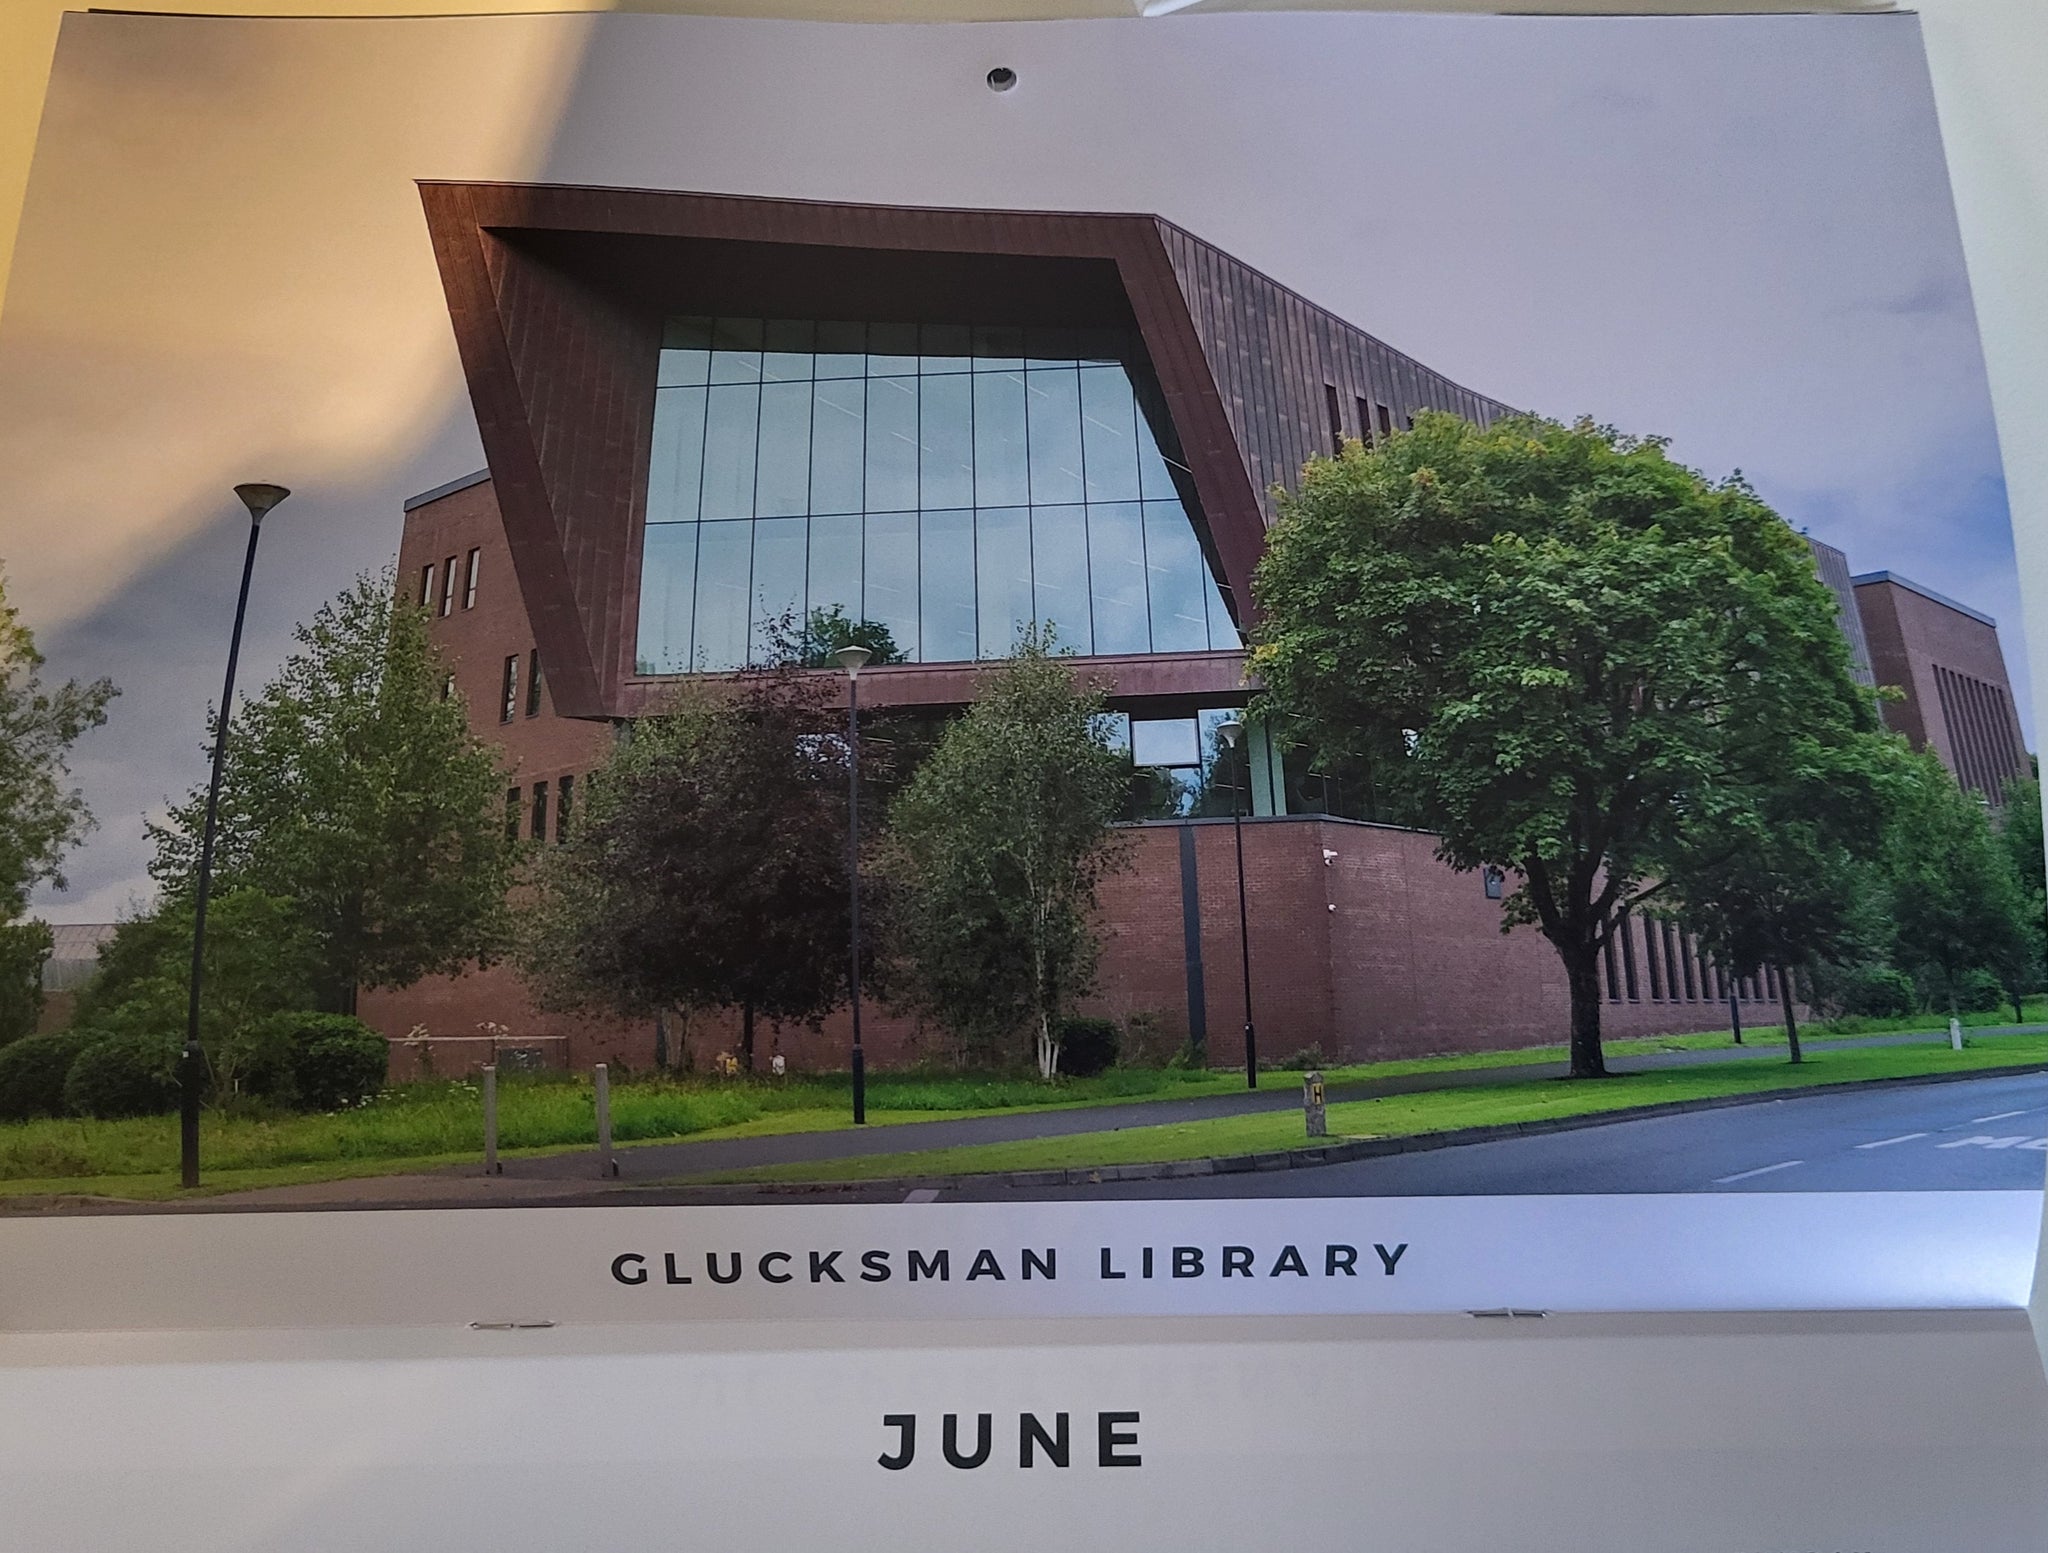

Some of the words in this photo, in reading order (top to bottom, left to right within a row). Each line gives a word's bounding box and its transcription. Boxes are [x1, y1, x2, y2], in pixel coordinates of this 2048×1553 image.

[610, 1247, 1057, 1286] GLUCKSMAN
[1100, 1243, 1410, 1280] LIBRARY
[877, 1411, 1143, 1471] JUNE
